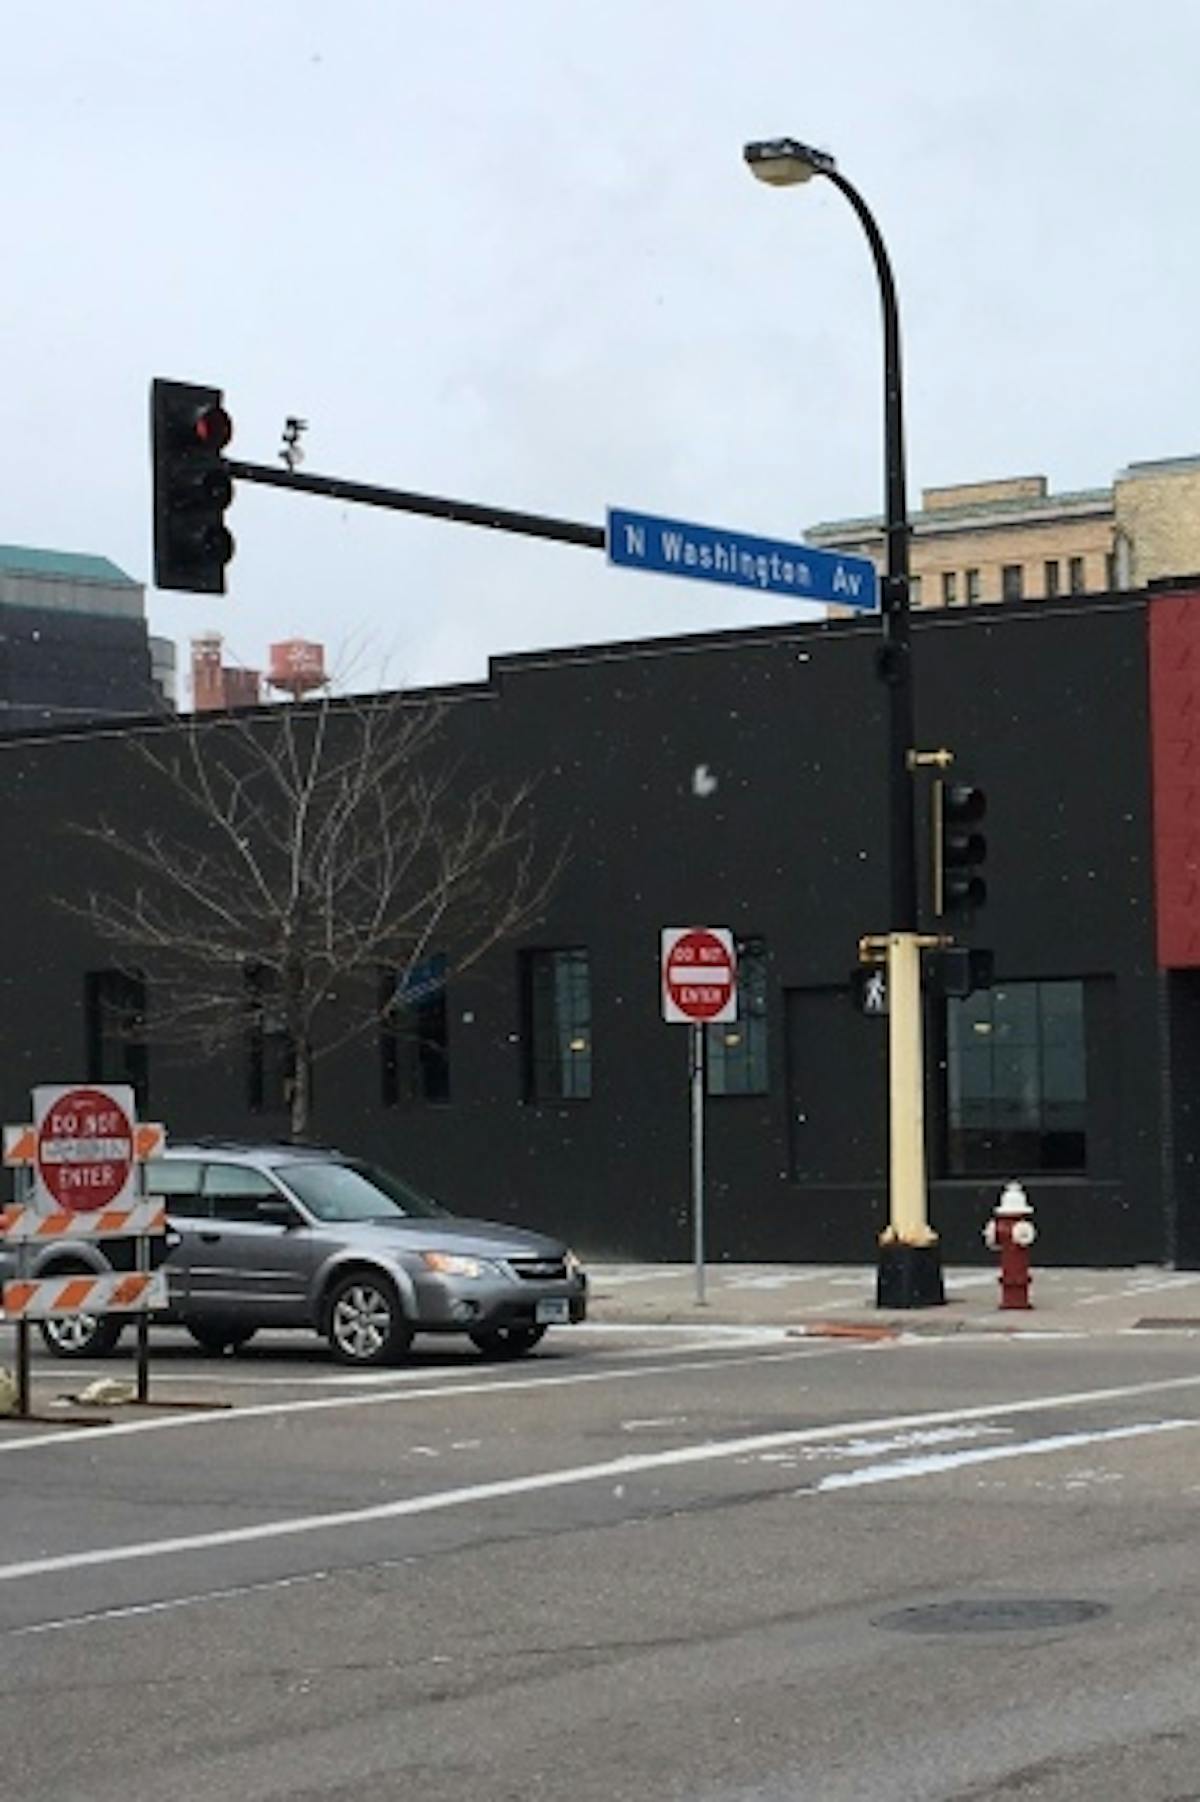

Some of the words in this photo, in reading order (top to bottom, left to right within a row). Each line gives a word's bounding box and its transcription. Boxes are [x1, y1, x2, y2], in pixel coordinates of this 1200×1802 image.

[624, 524, 646, 557] N
[661, 531, 811, 587] Washington
[832, 565, 863, 597] Av
[51, 1114, 78, 1133] DO
[85, 1111, 119, 1133] NOT
[59, 1166, 115, 1189] ENTER
